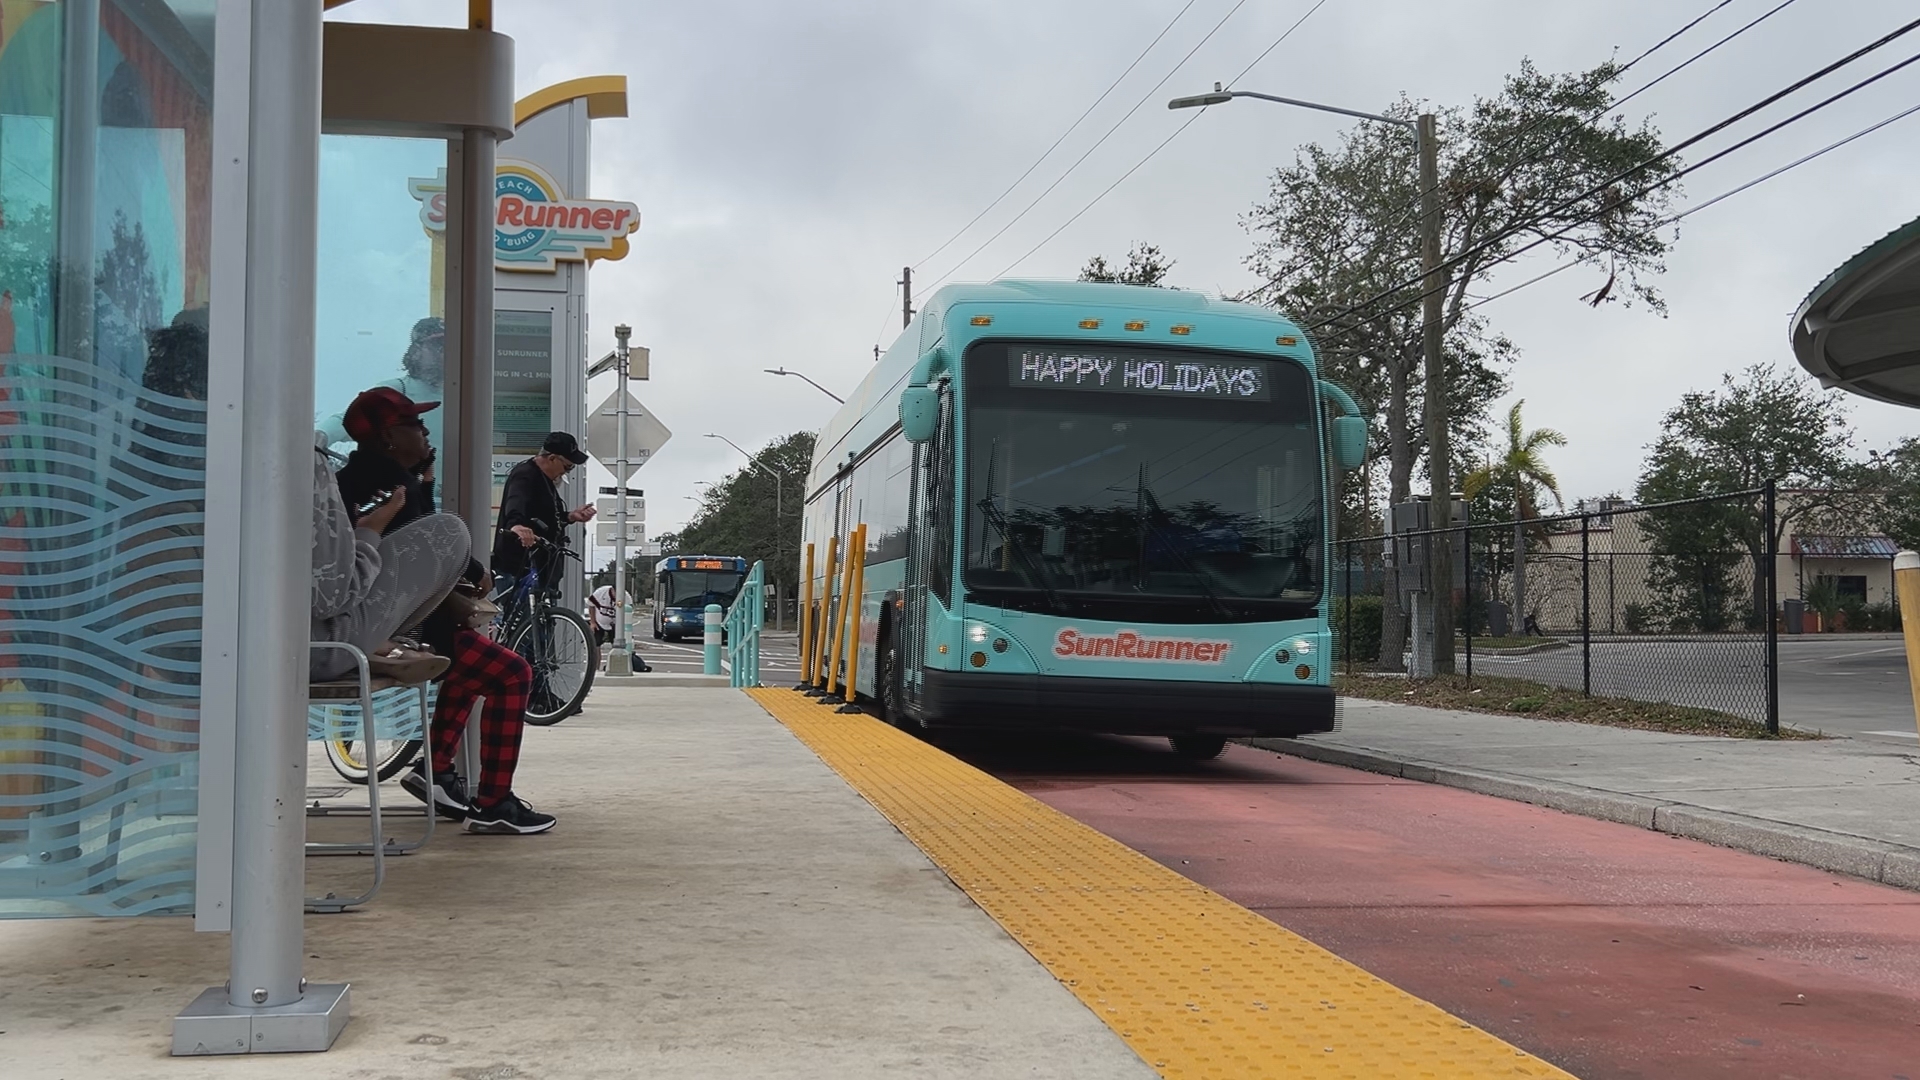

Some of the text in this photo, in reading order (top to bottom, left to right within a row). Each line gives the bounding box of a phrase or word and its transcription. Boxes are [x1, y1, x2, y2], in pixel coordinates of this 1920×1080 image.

[495, 180, 532, 195] EACH
[497, 349, 549, 358] SUNRUNNER
[1021, 351, 1262, 396] HAPPY HOLIDAYS
[1055, 629, 1231, 662] SunRunner
